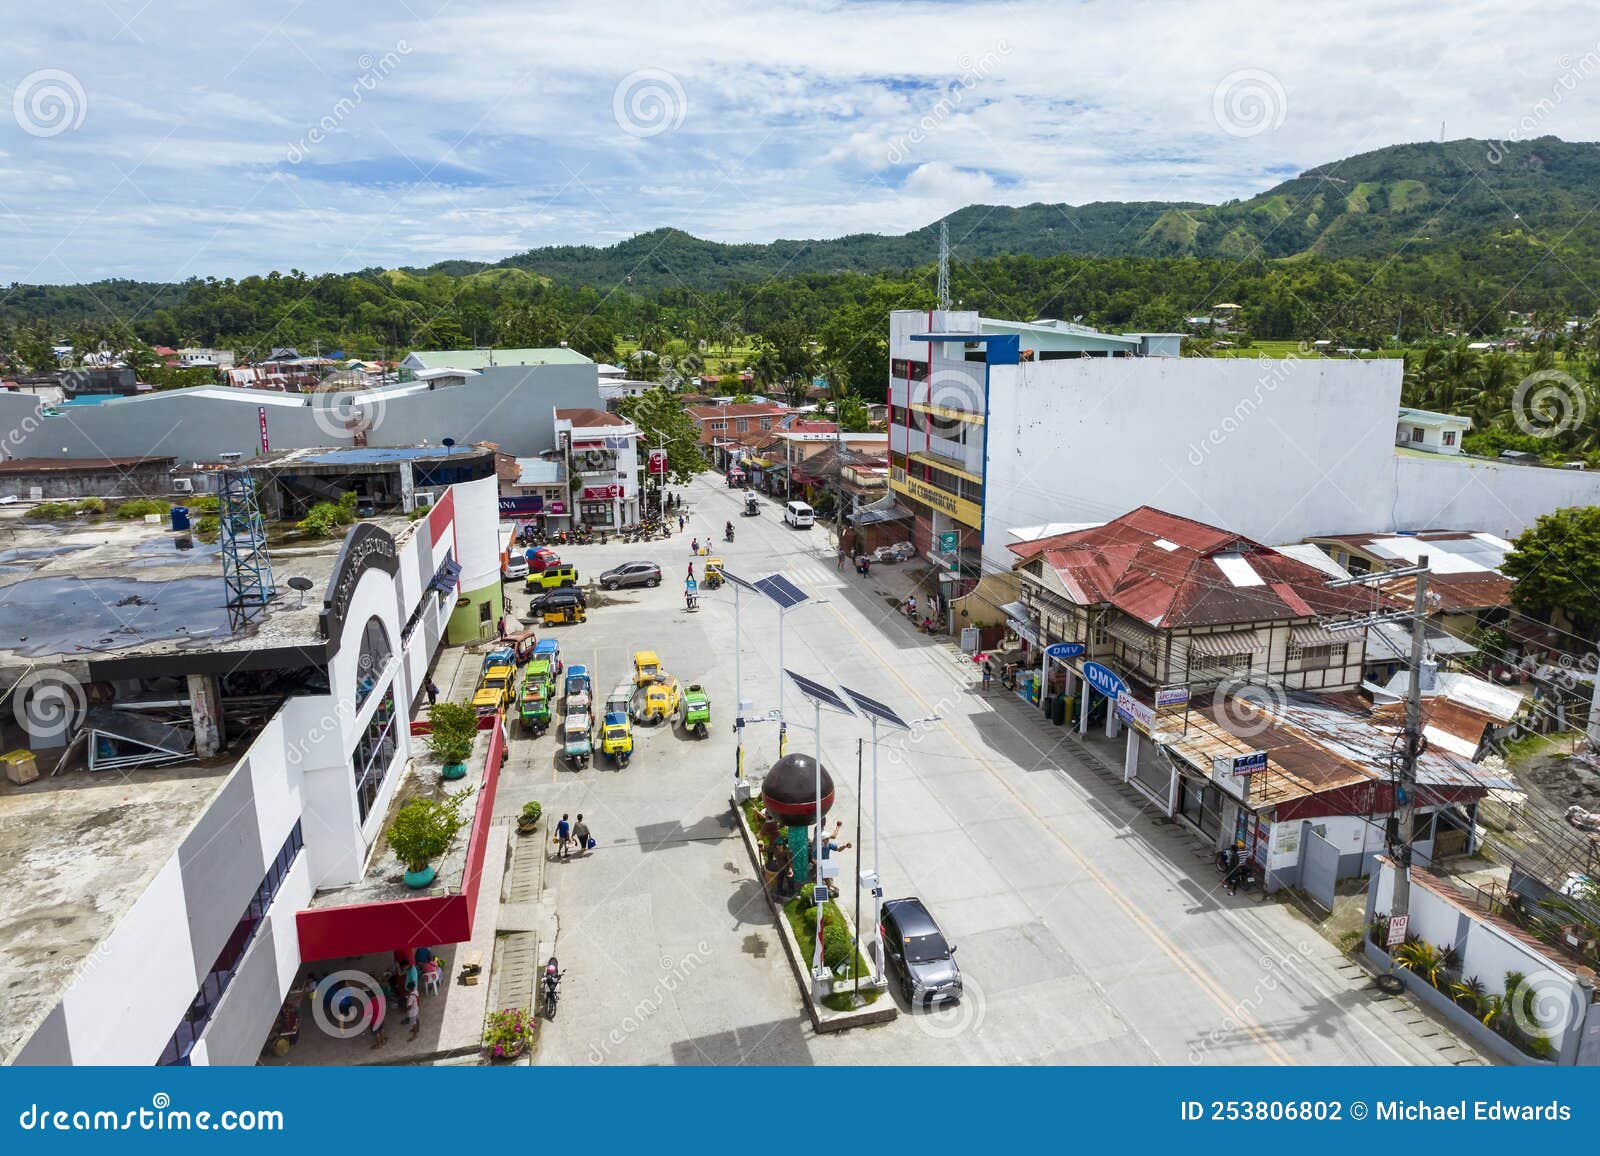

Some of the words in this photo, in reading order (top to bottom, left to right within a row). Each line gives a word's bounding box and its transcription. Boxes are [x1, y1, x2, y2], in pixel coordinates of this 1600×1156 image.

[1053, 645, 1079, 655] DMV
[1089, 665, 1119, 694] DMV
[1392, 917, 1406, 927] NO
